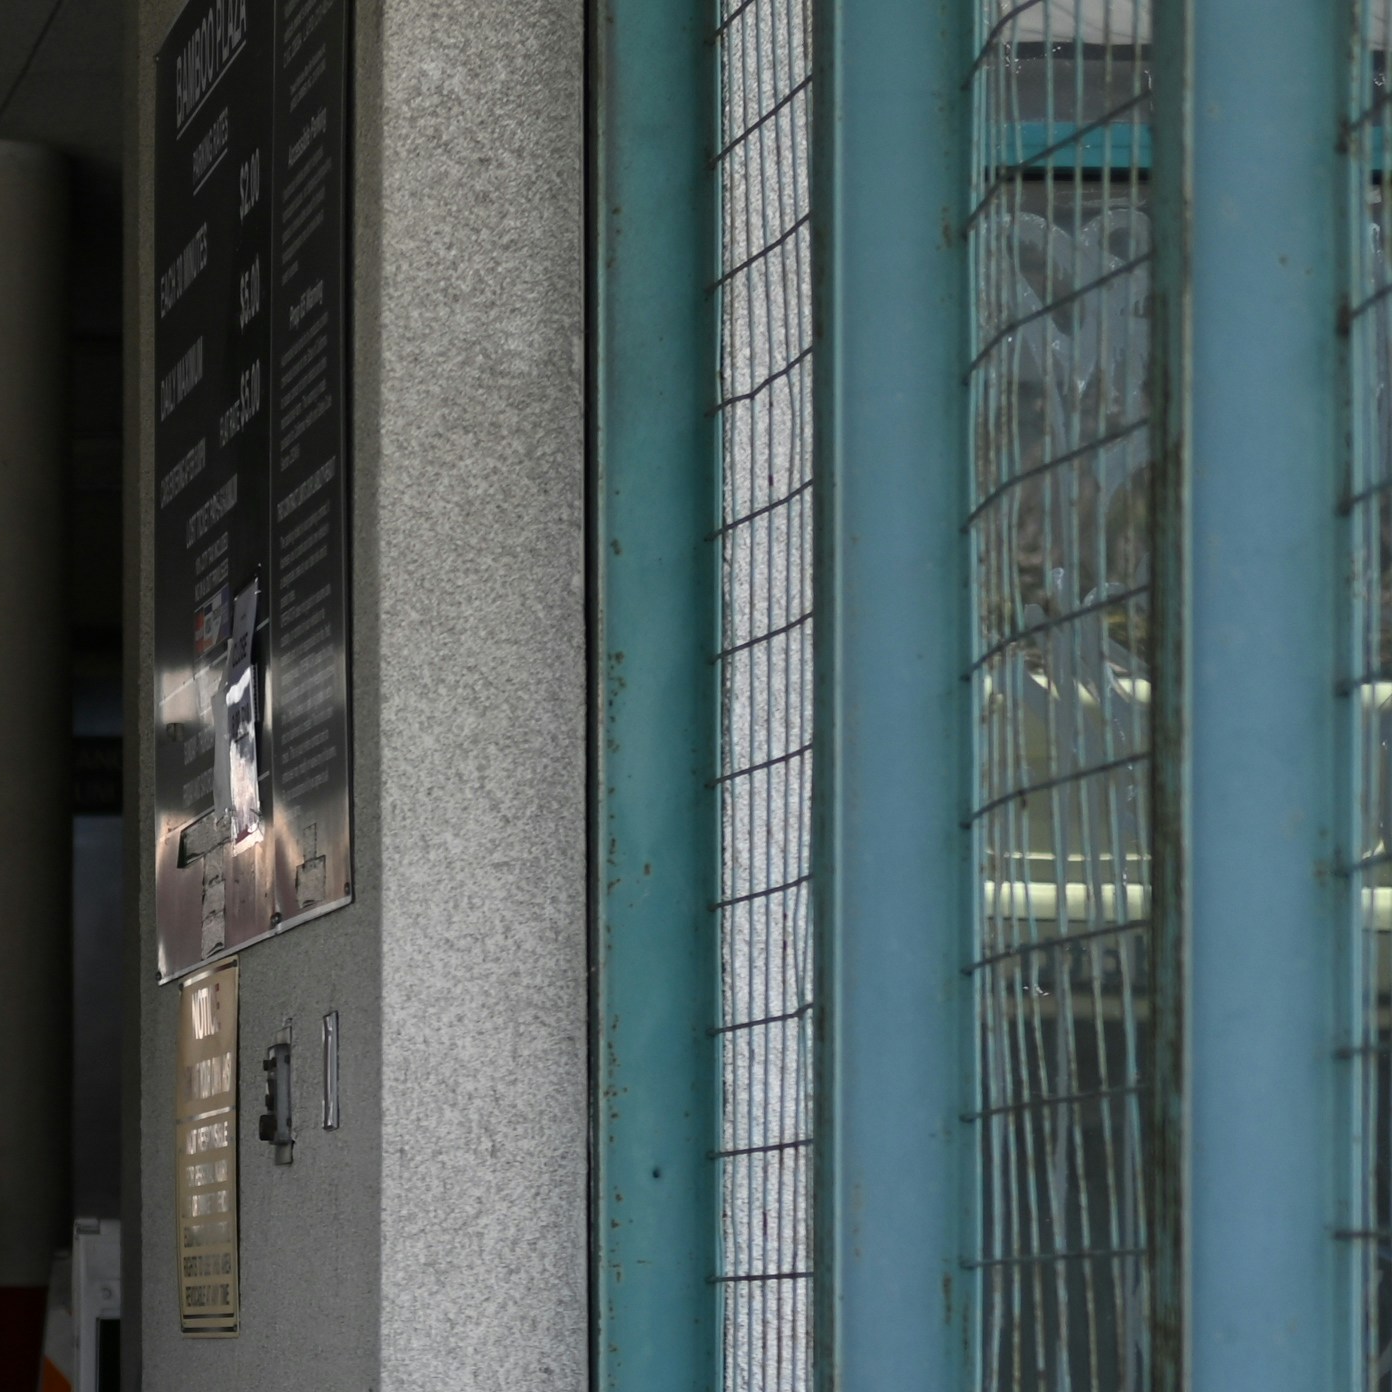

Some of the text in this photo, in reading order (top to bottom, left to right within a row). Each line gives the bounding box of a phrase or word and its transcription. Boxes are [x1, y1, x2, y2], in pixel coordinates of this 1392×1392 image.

[176, 8, 213, 129] BAMBOO
[213, 106, 228, 155] RATES
[240, 147, 260, 225] $2.00
[183, 220, 207, 292] MINUTES
[240, 252, 260, 334] $5.00
[240, 358, 260, 432] $5.00
